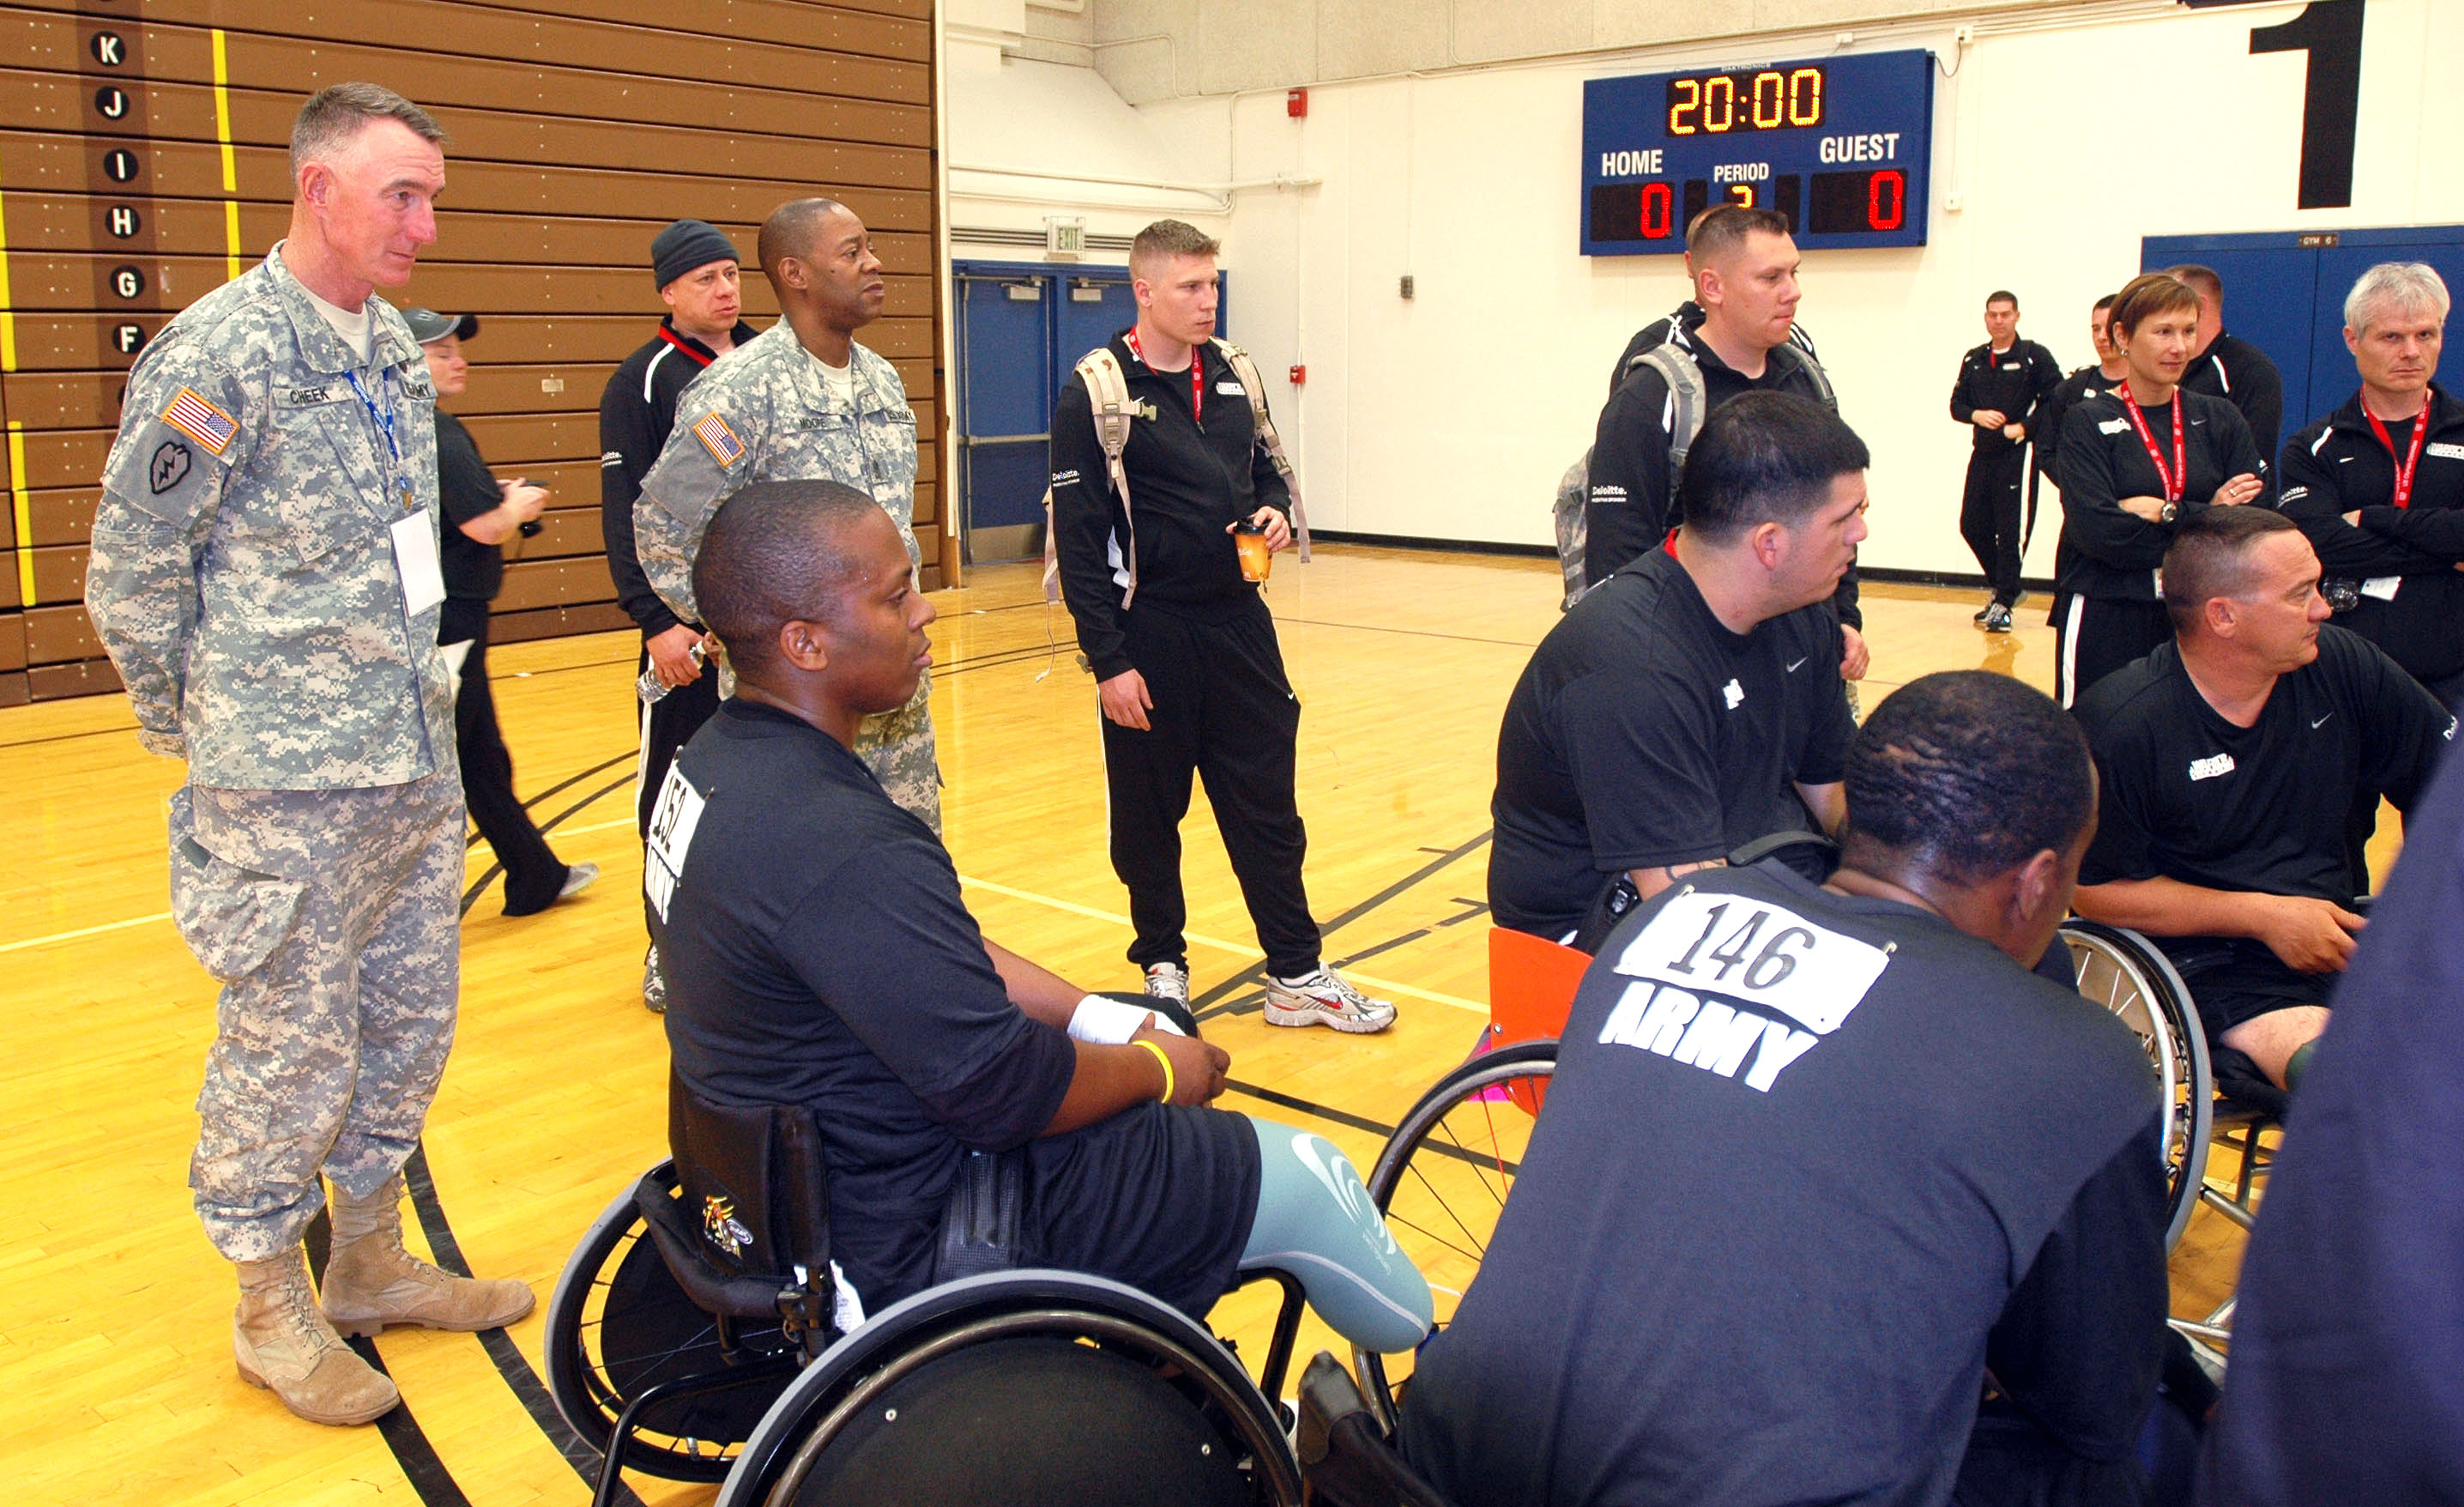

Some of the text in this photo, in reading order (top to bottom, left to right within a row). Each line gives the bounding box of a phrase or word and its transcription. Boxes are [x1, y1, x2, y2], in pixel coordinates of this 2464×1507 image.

[100, 36, 118, 64] K
[104, 90, 122, 117] J
[1669, 68, 1822, 136] 20:00
[2249, 0, 2365, 209] 1
[1819, 132, 1900, 164] GUEST
[117, 153, 126, 179] I
[1602, 149, 1663, 177] HOME
[1713, 162, 1770, 183] PERIOD
[1640, 182, 1672, 239] 0
[1868, 170, 1904, 231] 0
[112, 209, 133, 235] H
[1058, 227, 1078, 249] EXIT
[118, 271, 137, 298] G
[120, 326, 138, 353] F
[290, 386, 330, 404] CHEEK
[1666, 902, 1816, 990] 146
[1598, 980, 1820, 1092] ARMY
